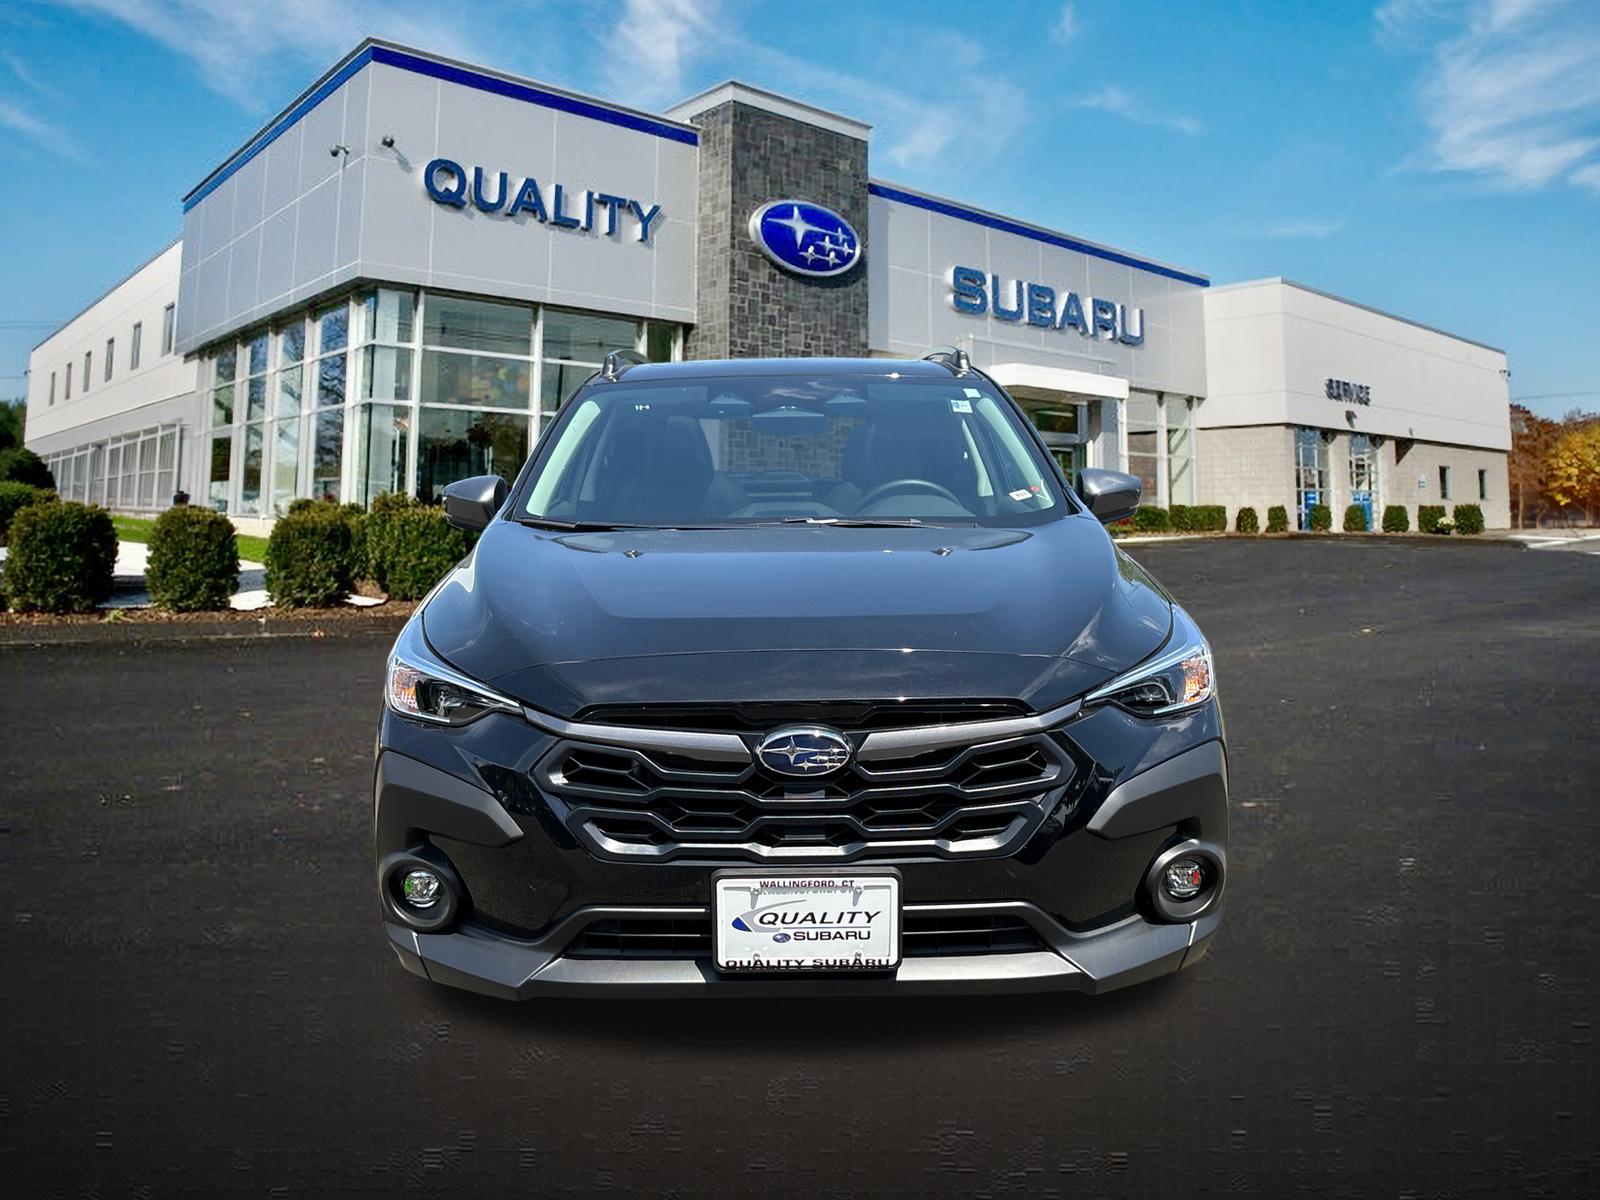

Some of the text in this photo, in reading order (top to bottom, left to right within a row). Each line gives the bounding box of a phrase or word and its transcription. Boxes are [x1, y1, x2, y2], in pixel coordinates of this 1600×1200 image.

[424, 158, 661, 242] QUALITY
[950, 265, 1145, 346] SUBARU
[841, 880, 855, 888] CT
[758, 911, 881, 925] QUALITY
[793, 930, 871, 941] SUBARU
[725, 958, 890, 968] QUALITY SUBARU
